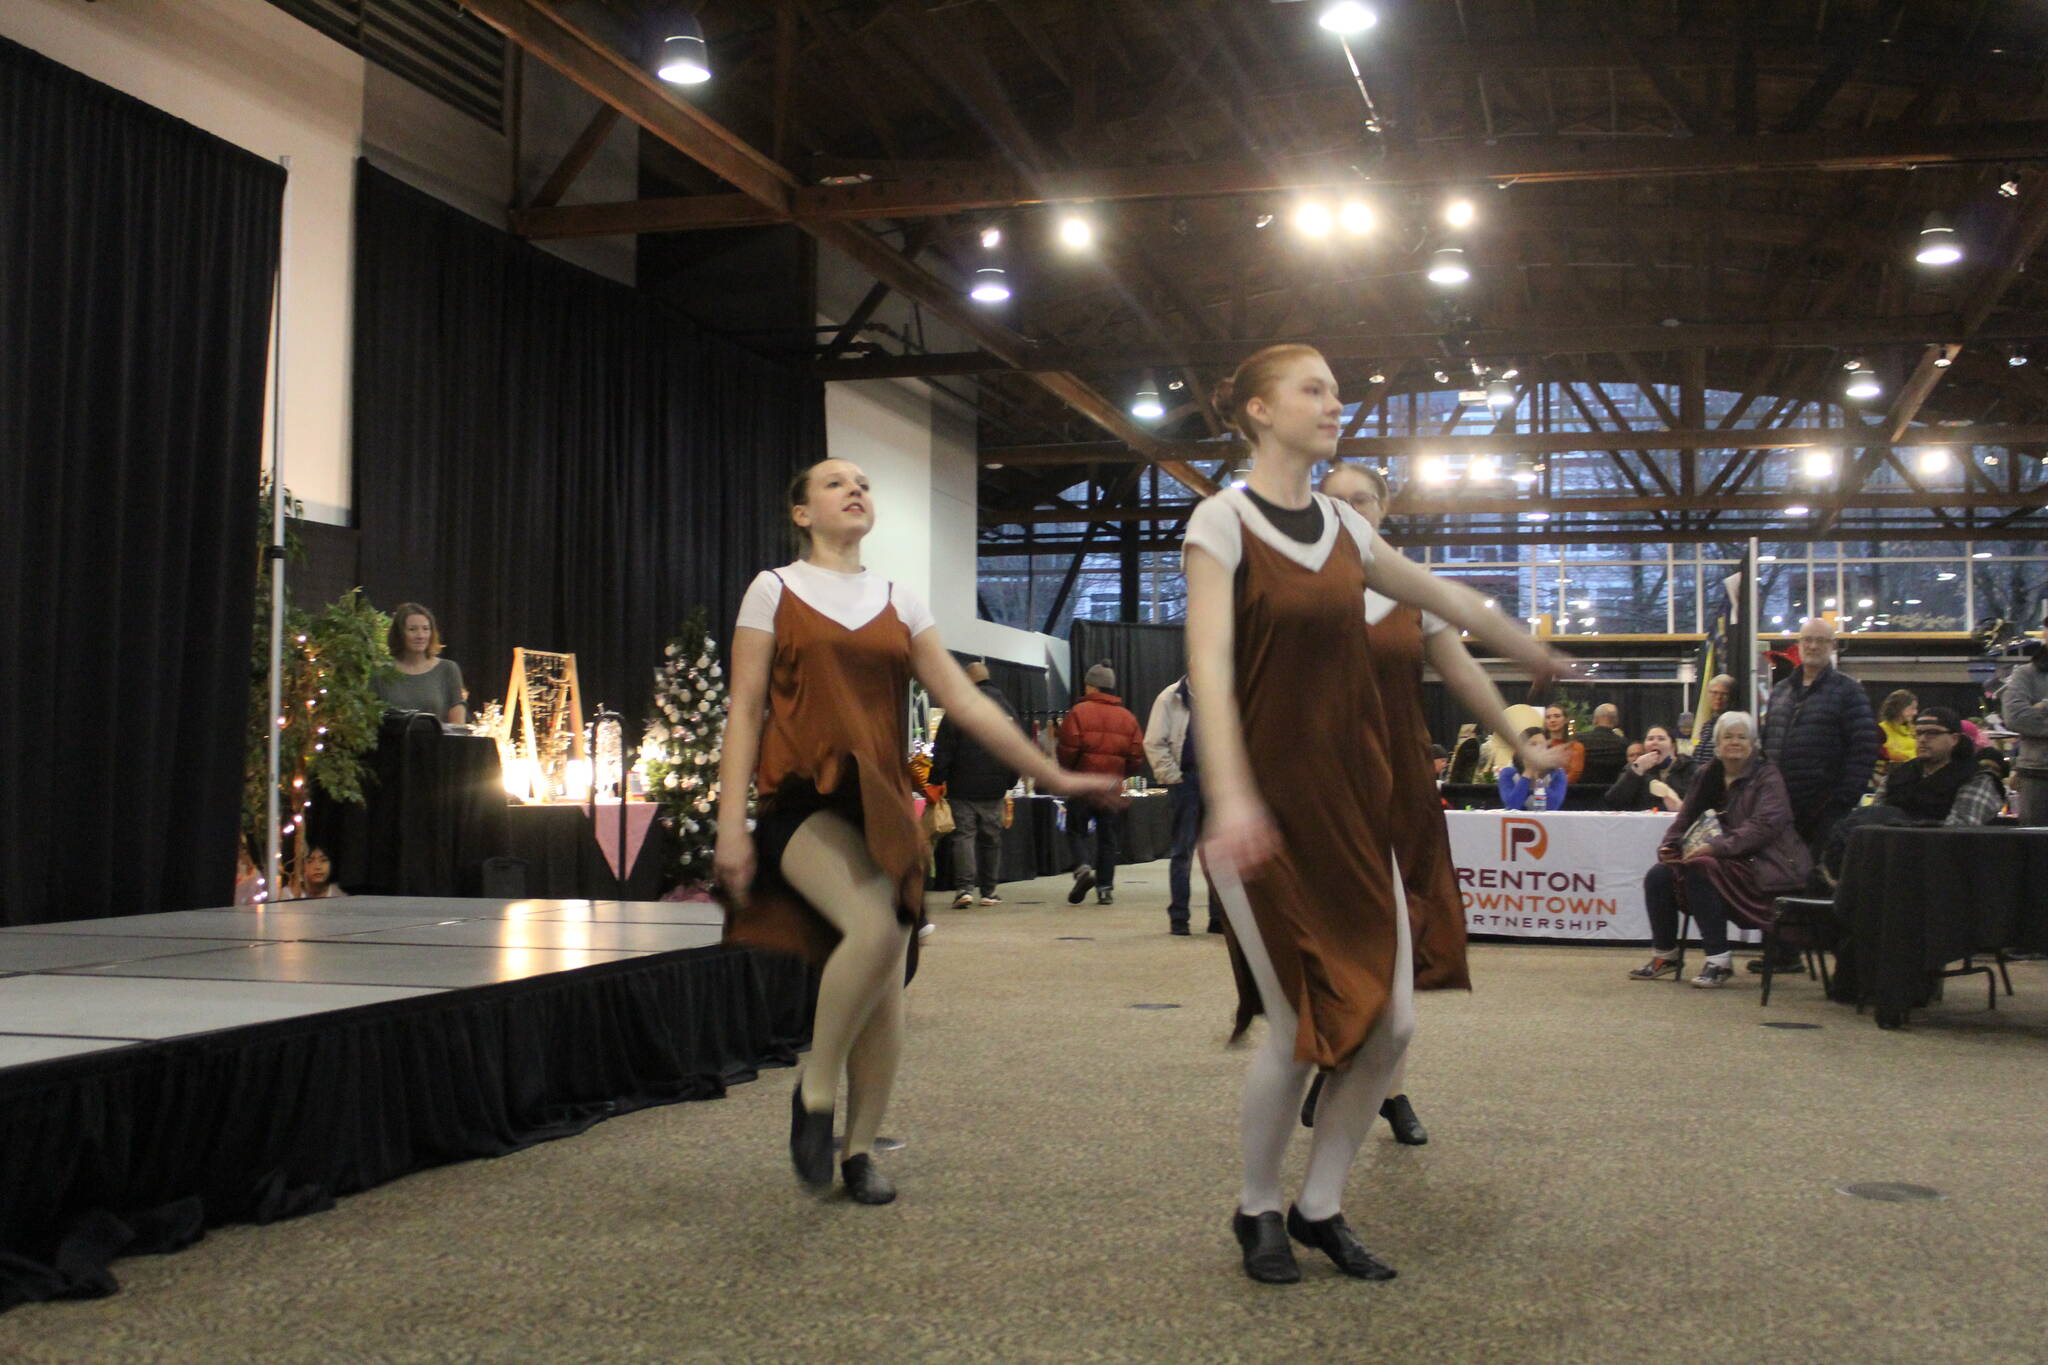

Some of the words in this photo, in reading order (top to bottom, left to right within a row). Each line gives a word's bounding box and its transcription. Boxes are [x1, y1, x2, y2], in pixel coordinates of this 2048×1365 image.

[1455, 867, 1595, 893] RENTON
[1460, 891, 1616, 915] OWNTOWN
[1472, 914, 1608, 931] RTNERSHIP
